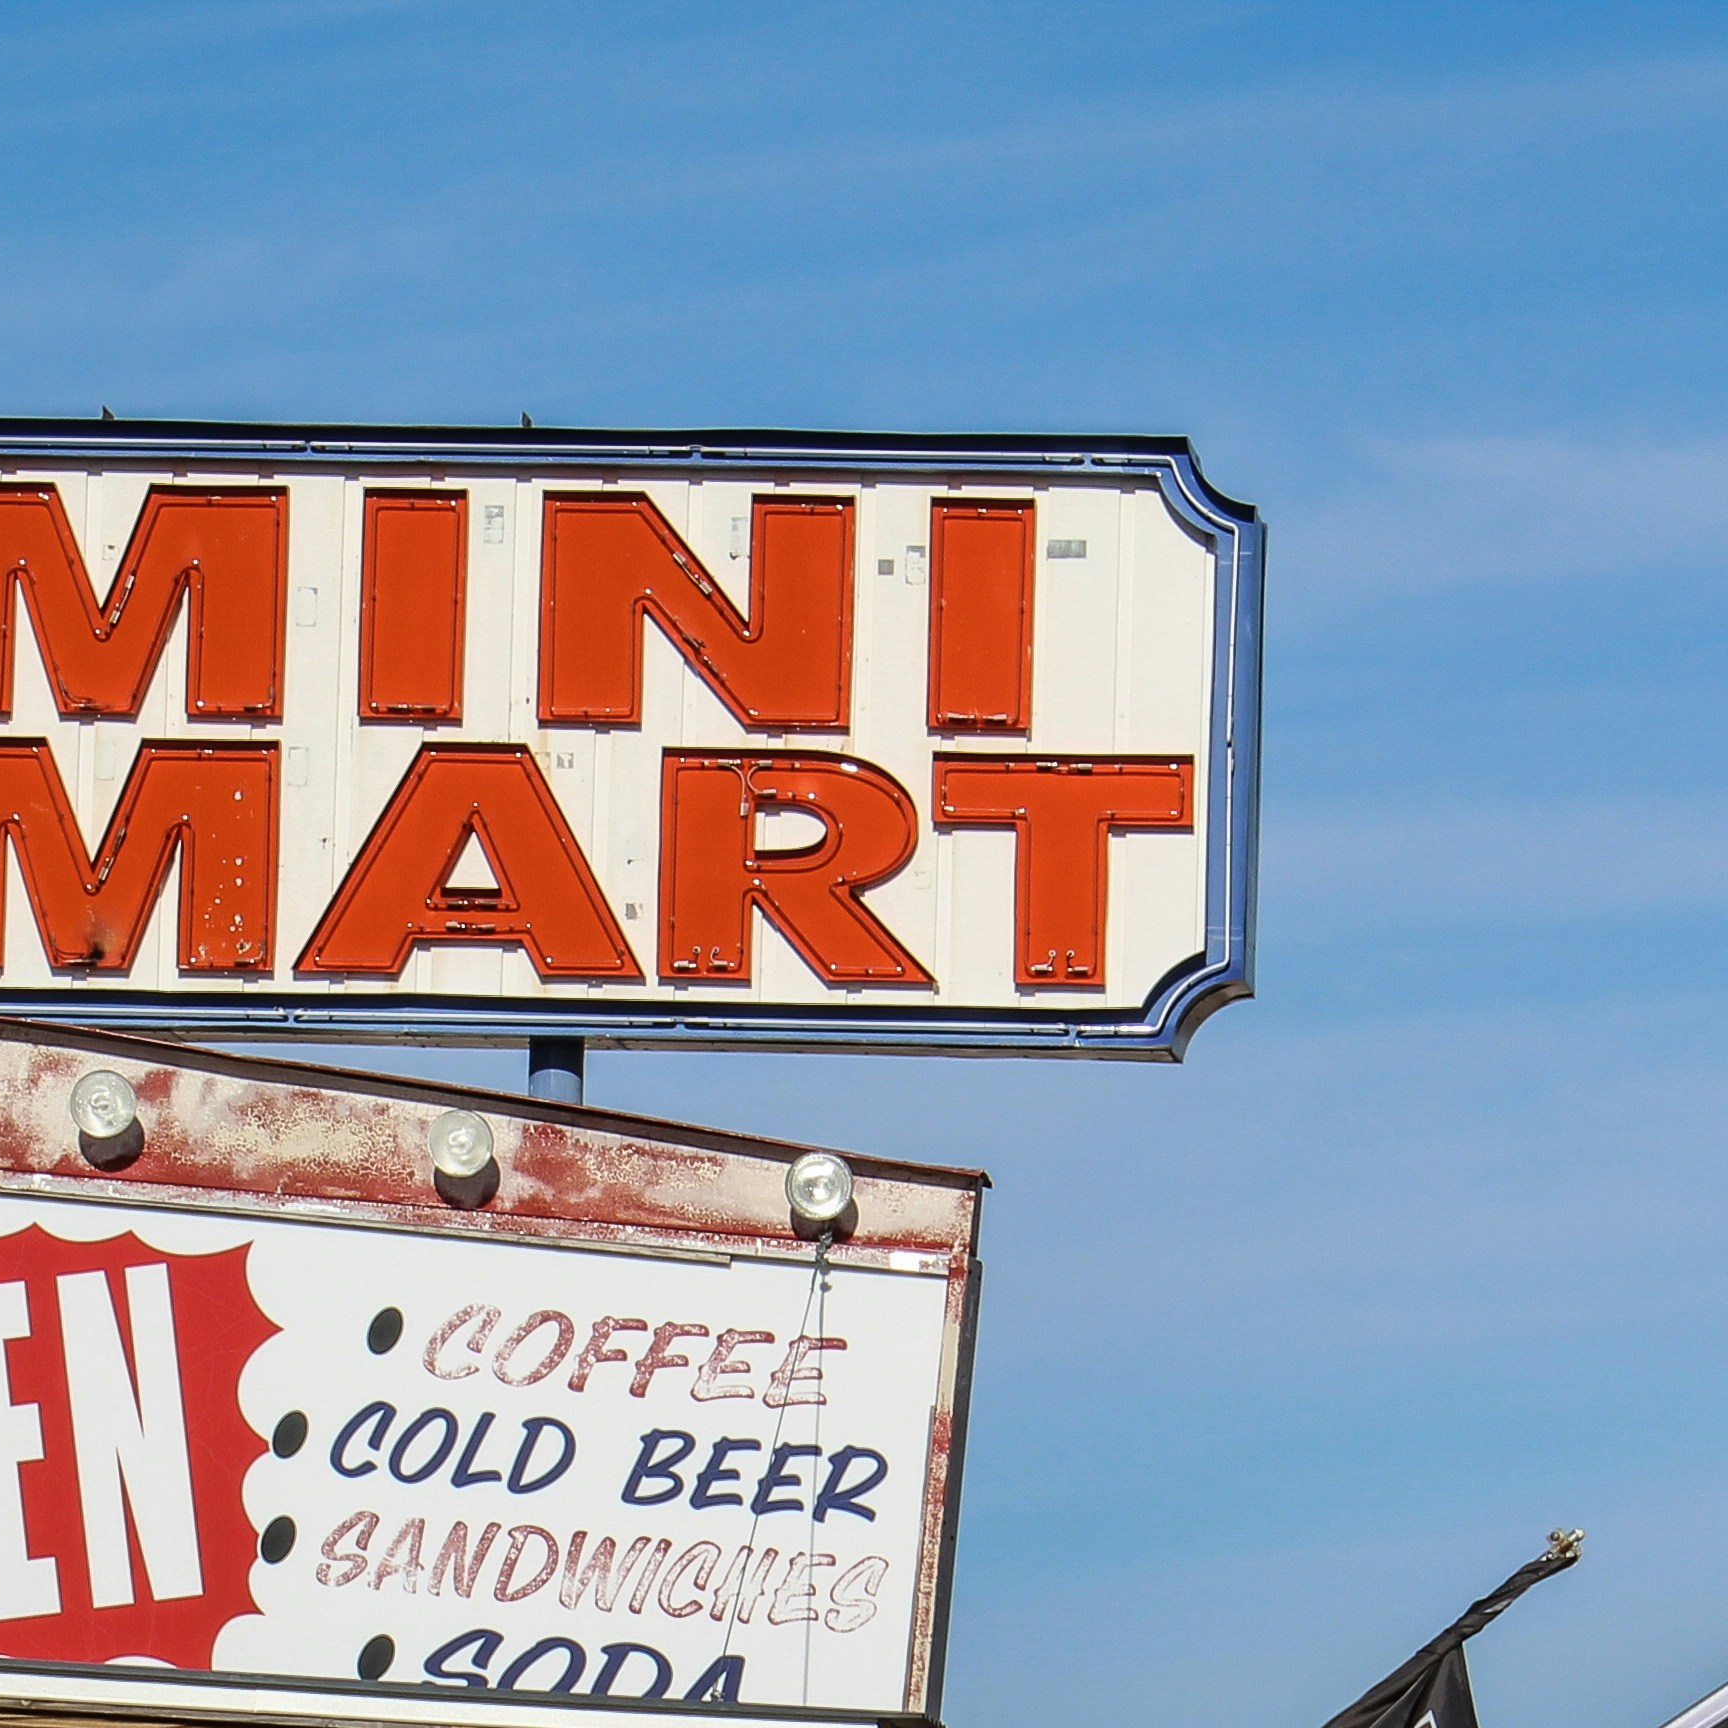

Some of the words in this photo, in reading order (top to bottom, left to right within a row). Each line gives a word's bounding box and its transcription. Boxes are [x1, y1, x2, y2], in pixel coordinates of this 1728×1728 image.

[421, 1303, 848, 1409] COFFEE
[329, 1400, 576, 1495] COLD
[621, 1427, 888, 1523] BEER
[315, 1510, 890, 1634] SANDWICHES
